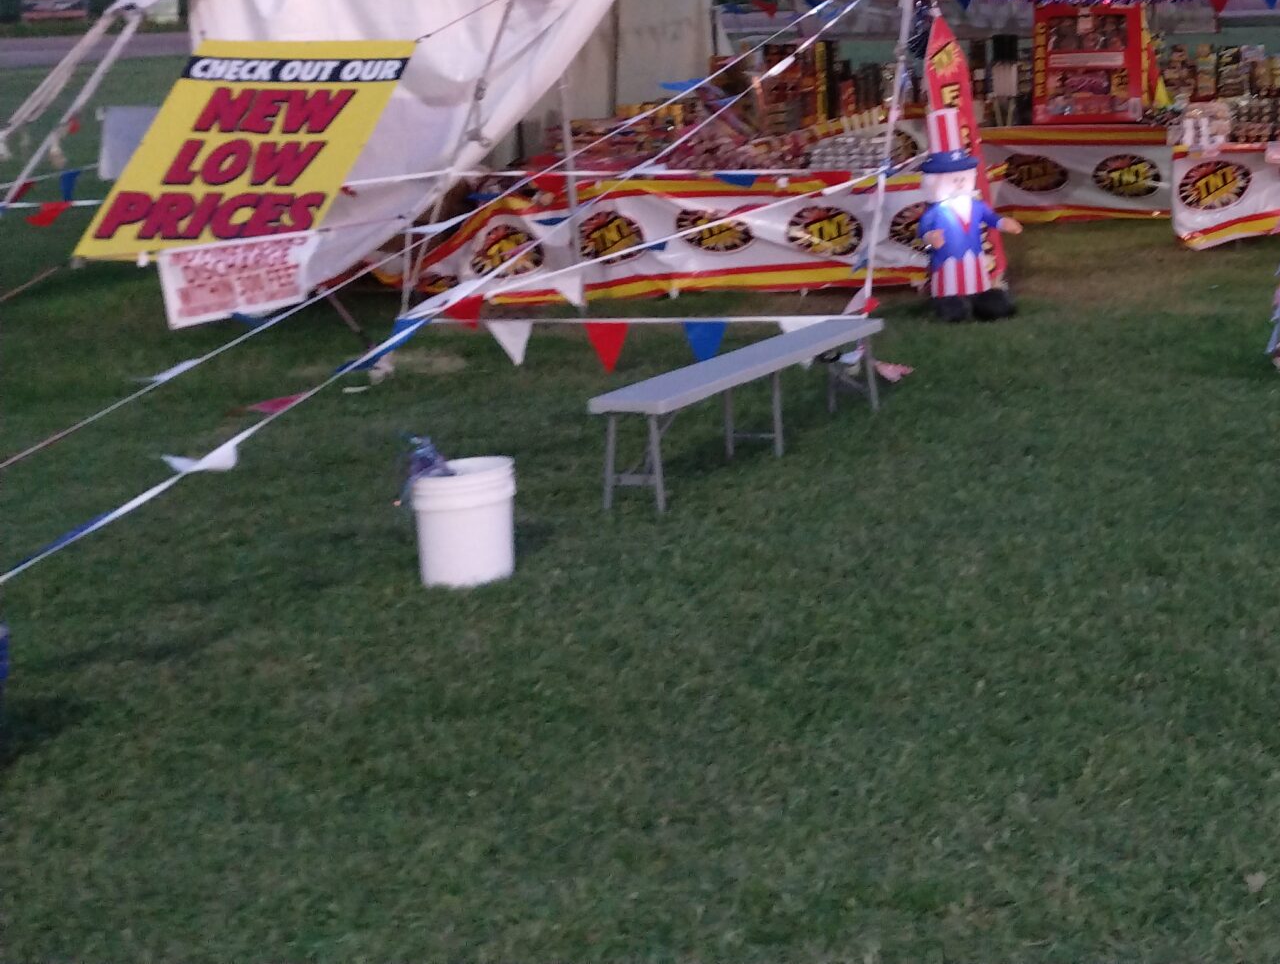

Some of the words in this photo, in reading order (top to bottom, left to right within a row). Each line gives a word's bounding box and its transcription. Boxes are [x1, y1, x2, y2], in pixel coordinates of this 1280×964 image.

[190, 57, 275, 80] CHECK
[279, 60, 337, 81] OUT
[339, 59, 402, 81] OUR
[193, 87, 357, 134] NEW
[162, 138, 328, 186] LOW
[1196, 167, 1237, 199] TNT
[93, 190, 326, 240] PRICES
